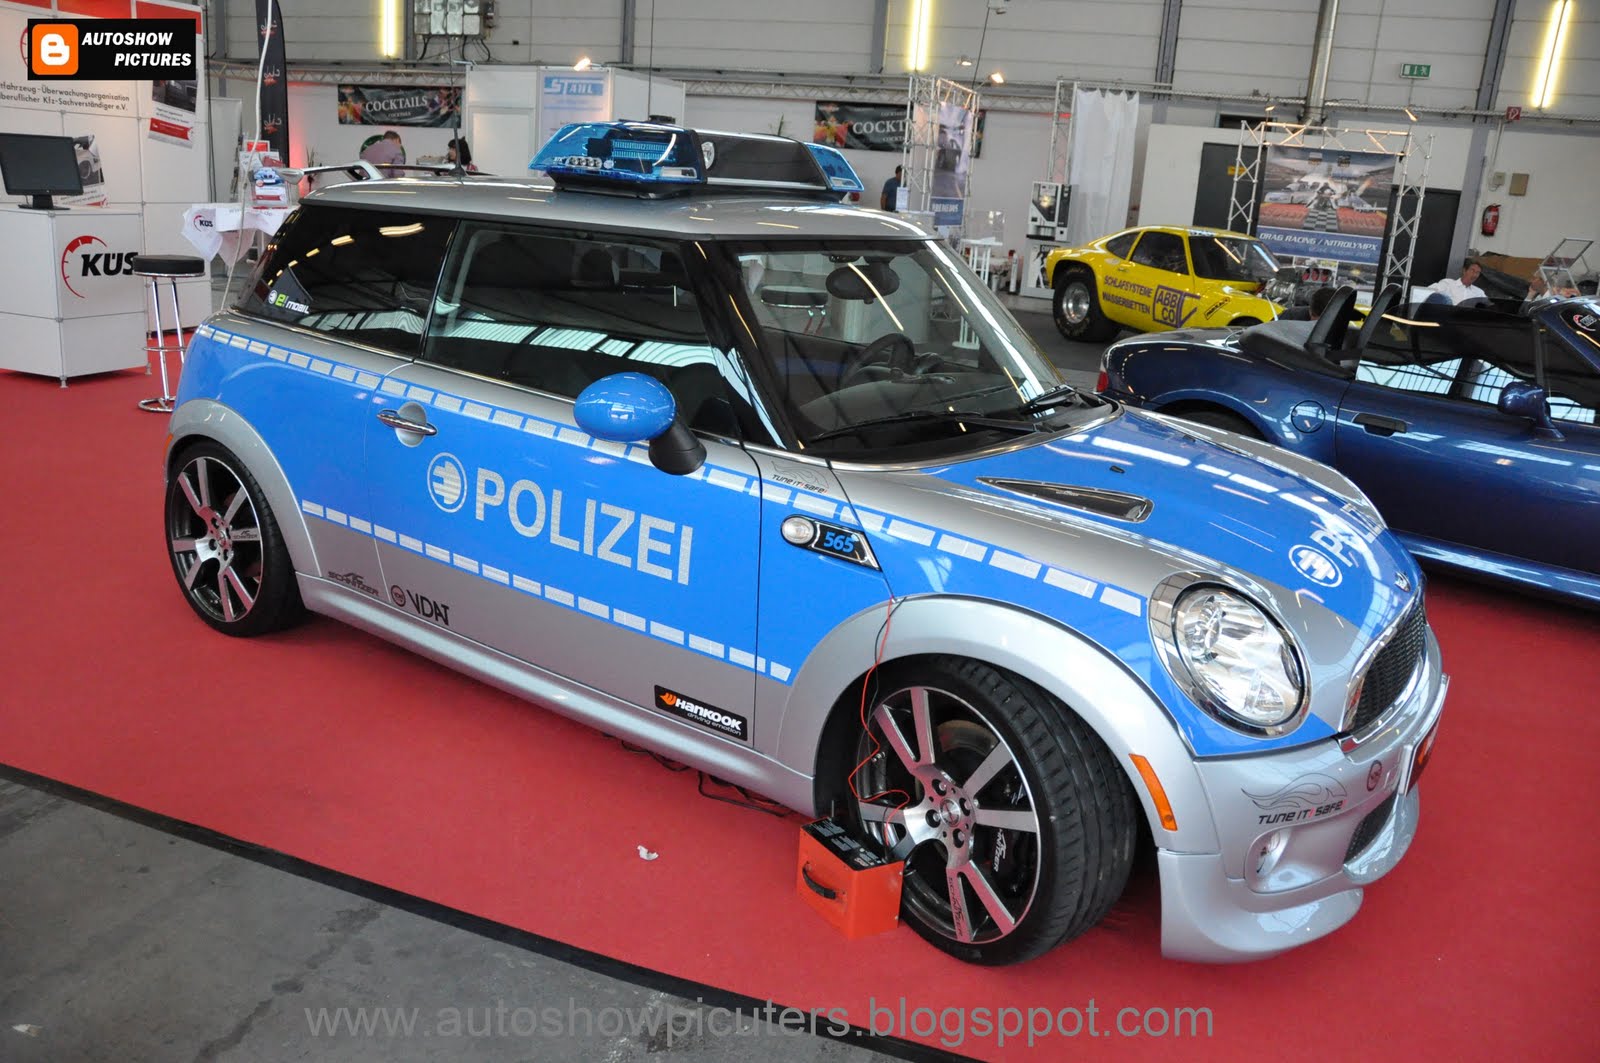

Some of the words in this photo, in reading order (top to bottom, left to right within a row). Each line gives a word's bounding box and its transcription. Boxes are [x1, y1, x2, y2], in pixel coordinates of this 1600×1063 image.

[366, 96, 428, 112] COCKTAILS
[1259, 232, 1283, 241] DRAG
[1285, 236, 1316, 245] RACING
[1157, 290, 1178, 308] ABB
[1162, 307, 1175, 322] CO
[475, 467, 693, 585] POLIZEI
[824, 531, 854, 553] 565
[406, 589, 450, 626] VDAT
